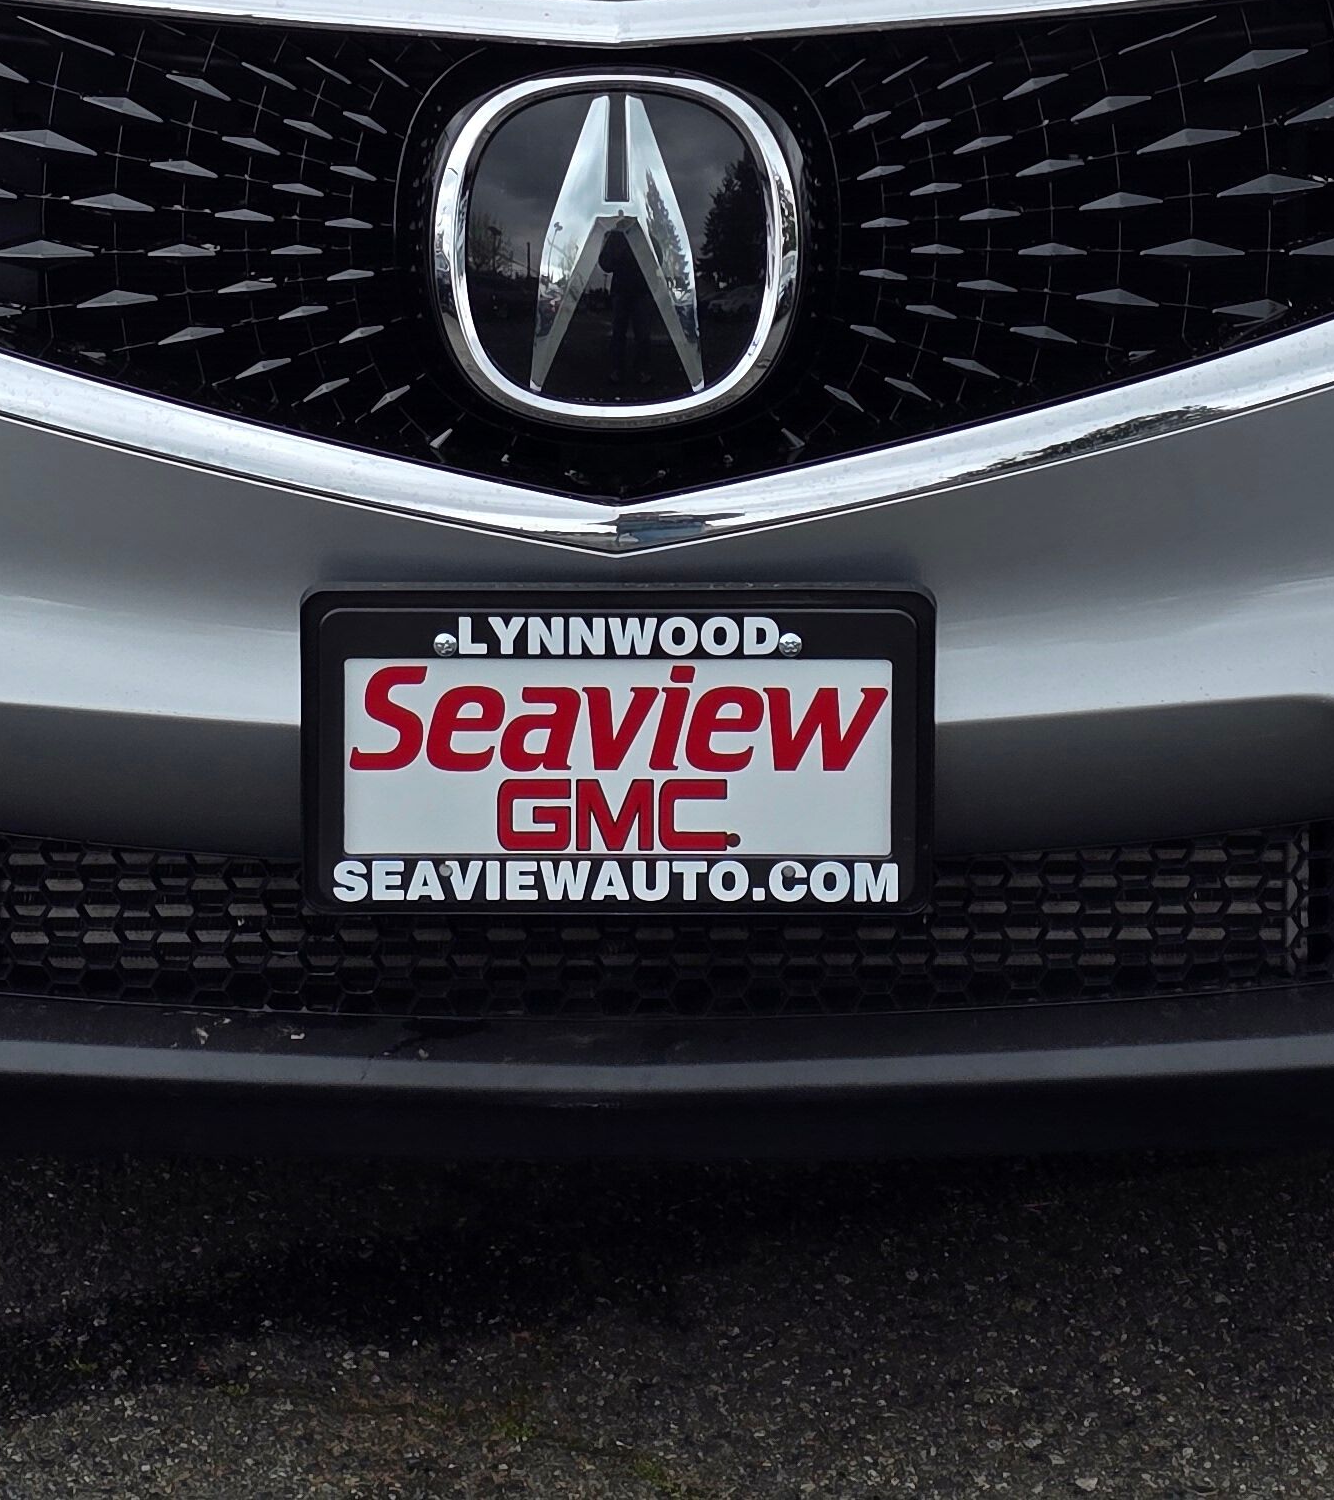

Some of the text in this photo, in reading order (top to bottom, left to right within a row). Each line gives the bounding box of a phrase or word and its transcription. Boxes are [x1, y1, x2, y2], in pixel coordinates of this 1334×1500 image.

[457, 615, 780, 656] LYNNWOOD
[349, 665, 889, 772] Seaview
[496, 778, 731, 852] GMC
[332, 860, 899, 903] SEAVIEWAUTO.COM
